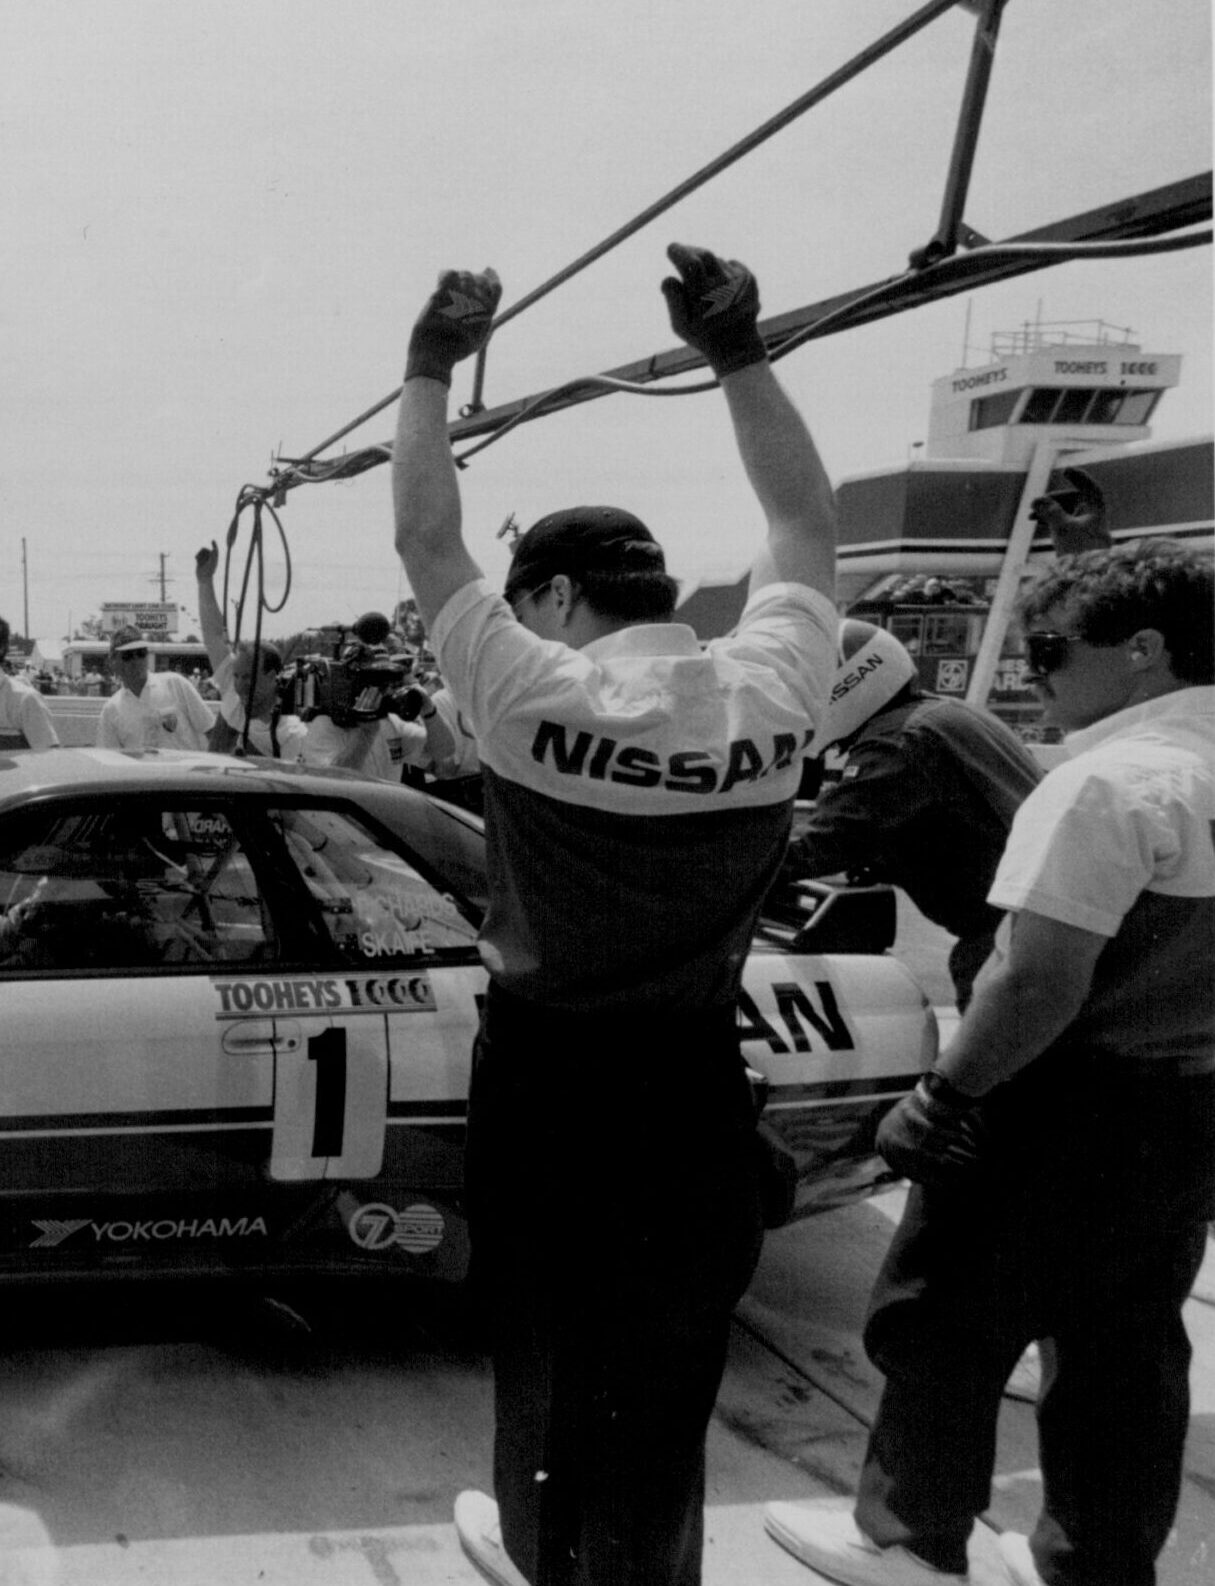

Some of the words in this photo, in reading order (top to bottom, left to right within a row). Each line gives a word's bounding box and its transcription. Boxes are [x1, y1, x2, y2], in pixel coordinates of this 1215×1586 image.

[952, 367, 1008, 394] TOOHEYS
[1053, 360, 1107, 375] TOOHEYS
[828, 653, 883, 706] ISSAN
[214, 979, 342, 1012] TOOHEYS
[345, 977, 429, 1007] 1000
[308, 1027, 347, 1158] 1
[91, 1216, 268, 1242] YOKOHAMA
